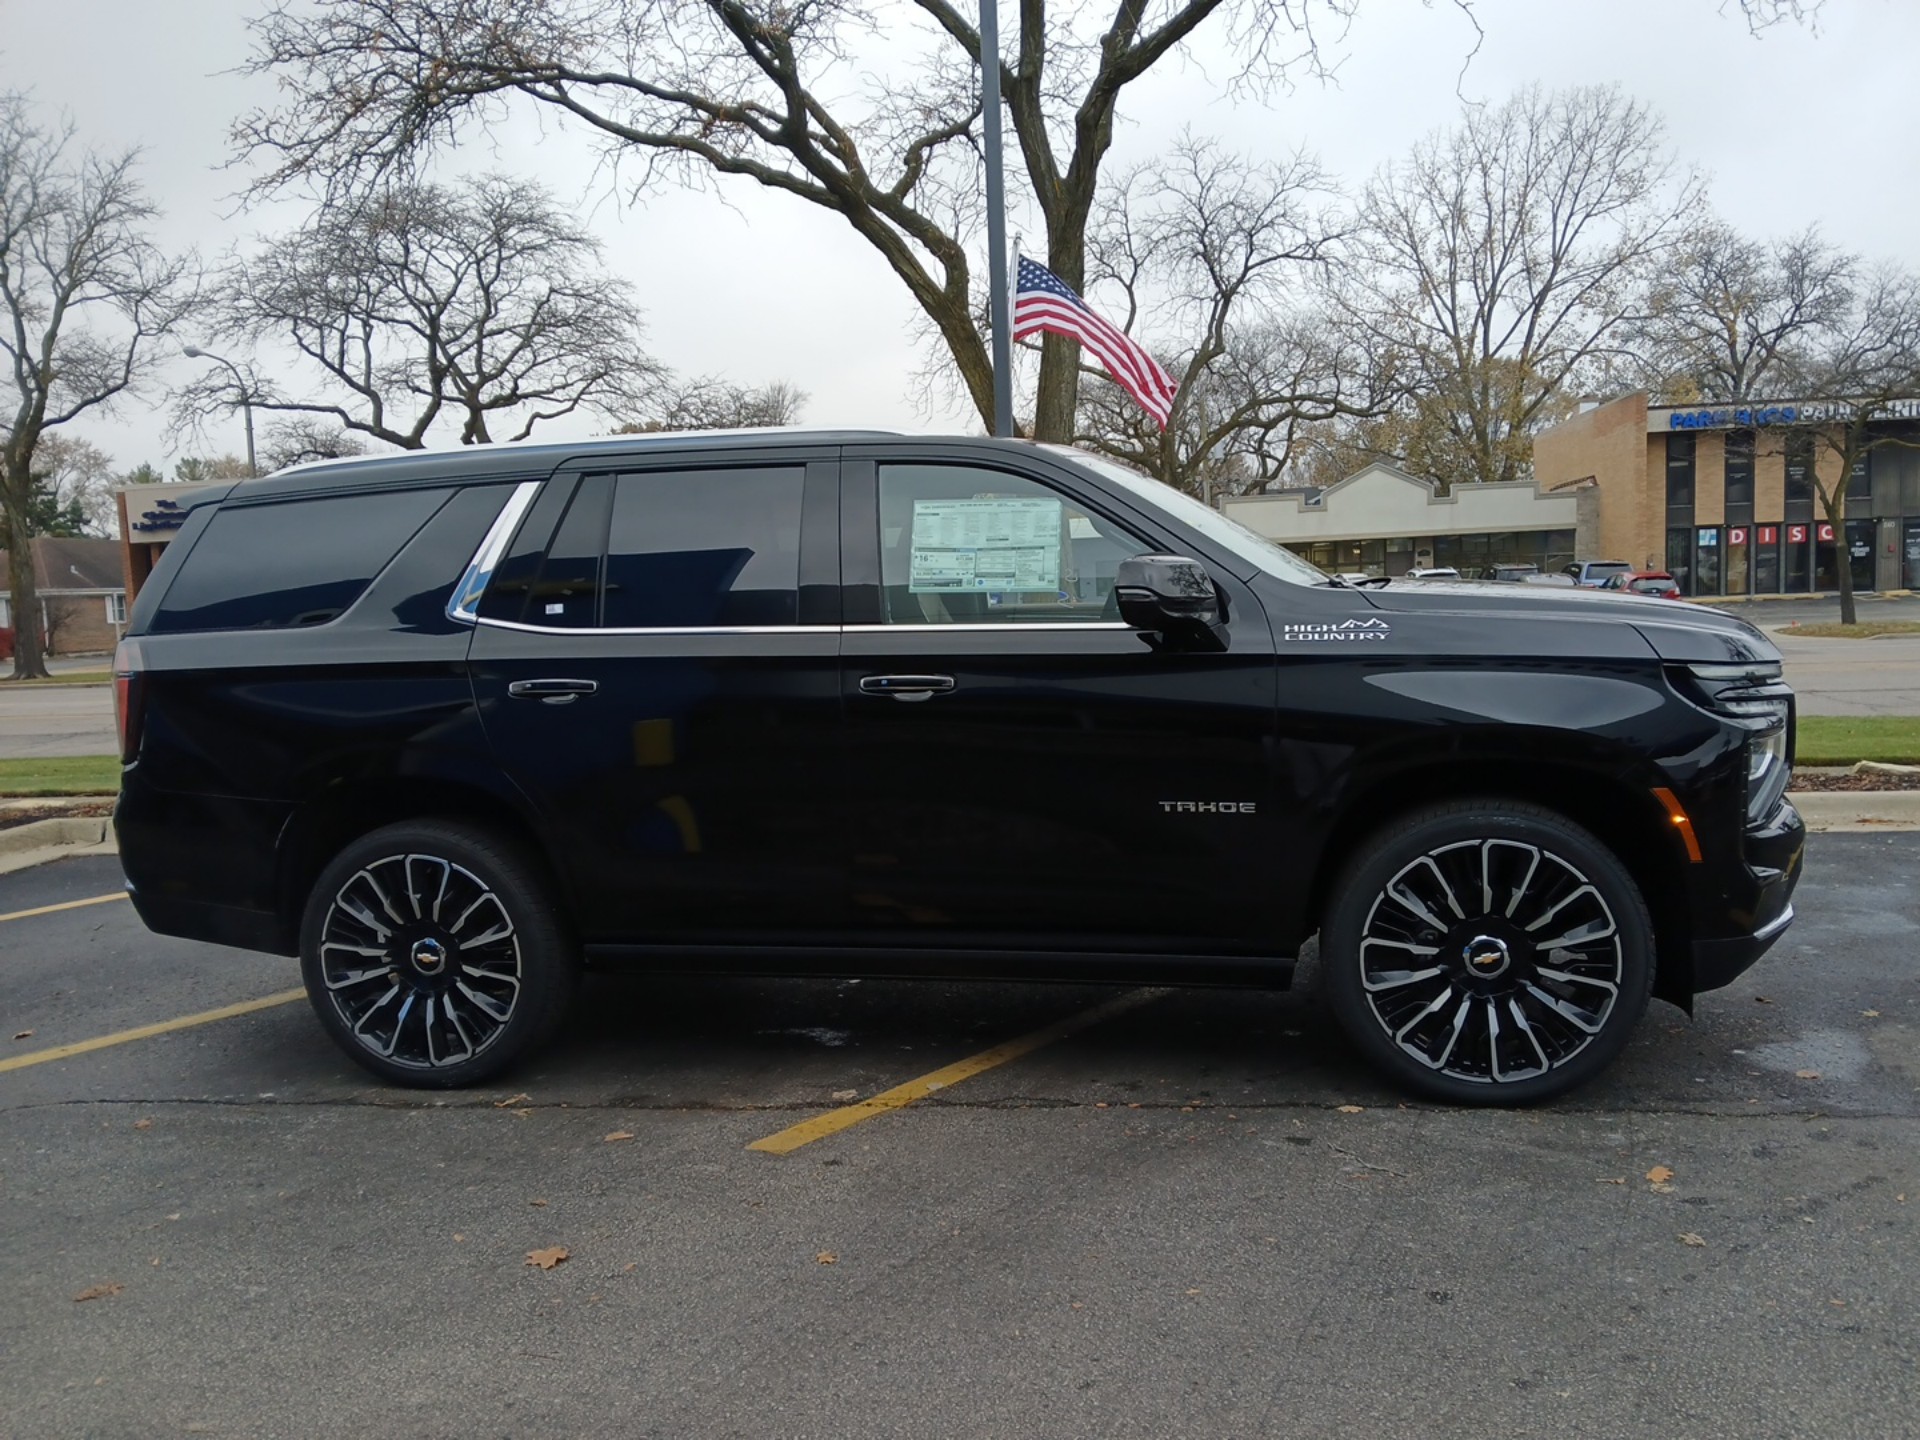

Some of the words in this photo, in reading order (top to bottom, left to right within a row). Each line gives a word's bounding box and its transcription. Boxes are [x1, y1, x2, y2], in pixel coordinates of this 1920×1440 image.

[1284, 624, 1337, 632] HIGH
[1284, 632, 1391, 640] COUNTRY
[1158, 801, 1256, 813] TAHOE
